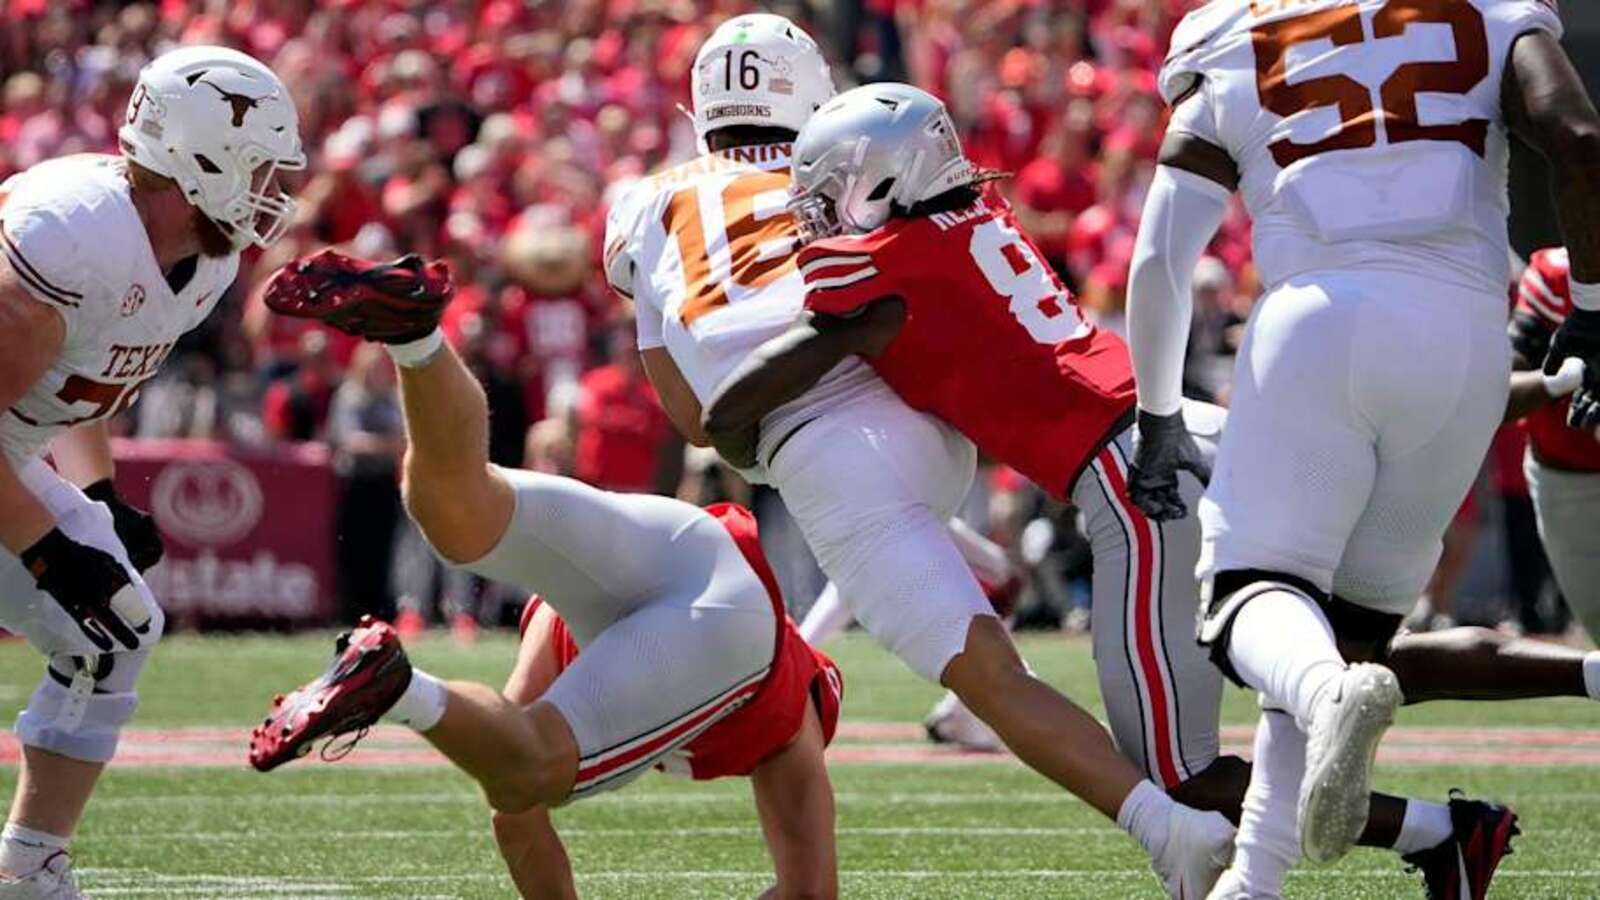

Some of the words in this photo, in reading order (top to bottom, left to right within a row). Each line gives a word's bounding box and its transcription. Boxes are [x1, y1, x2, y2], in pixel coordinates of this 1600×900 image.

[725, 50, 759, 90] 16
[1250, 0, 1491, 169] 52
[662, 166, 798, 329] 16
[969, 216, 1095, 345] 8
